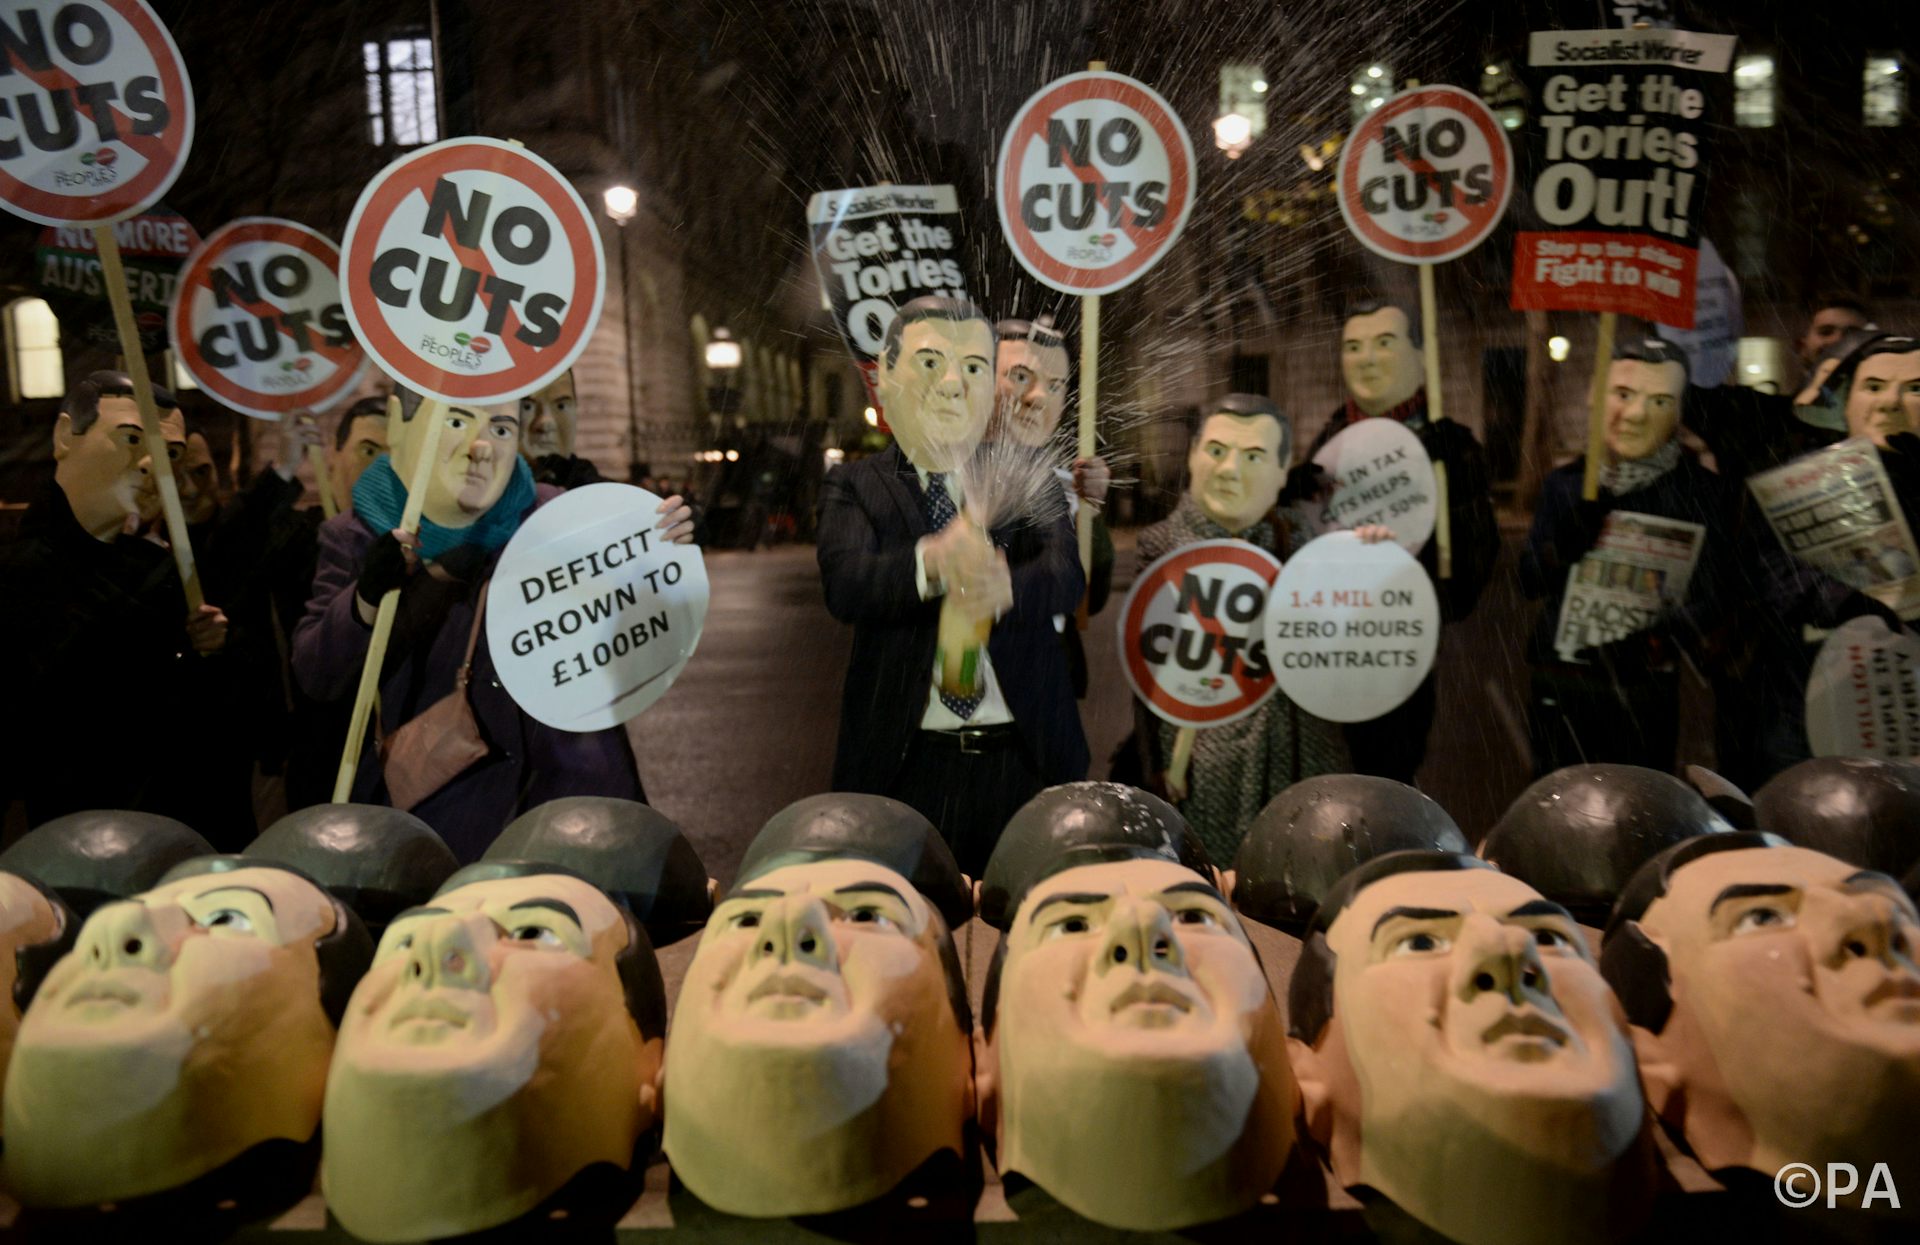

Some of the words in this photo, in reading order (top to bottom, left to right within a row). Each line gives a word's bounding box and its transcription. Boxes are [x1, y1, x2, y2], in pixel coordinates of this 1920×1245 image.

[0, 3, 112, 76] NO
[1543, 74, 1628, 113] Get
[1639, 74, 1704, 119] the
[1047, 118, 1142, 168] NO
[1383, 119, 1466, 163] NO
[1540, 115, 1699, 169] Tories
[828, 194, 890, 217] Scialist
[1021, 181, 1168, 232] CUTS
[1361, 164, 1493, 215] CUTS
[1534, 162, 1696, 238] Out!
[56, 227, 97, 249] NO
[113, 220, 189, 254] MORE
[422, 177, 551, 265] NO
[827, 221, 898, 261] Get
[899, 218, 953, 250] the
[209, 255, 310, 309] NO
[369, 247, 567, 348] CUTS
[831, 251, 964, 301] Tories
[1535, 257, 1605, 287] Fight
[1611, 261, 1640, 285] to
[201, 303, 354, 369] CUTS
[1349, 465, 1369, 484] IN
[1372, 446, 1406, 471] TAX
[1360, 471, 1411, 503] HELPS
[520, 528, 652, 605] DEFICIT
[511, 583, 637, 657] GROWN
[644, 561, 683, 595] TO
[1175, 572, 1265, 624] NO
[1291, 591, 1324, 608] 1.4
[1332, 590, 1374, 608] MIL
[1381, 590, 1413, 607] ON
[552, 611, 670, 687] £100BN
[1140, 623, 1272, 678] CUTS
[1277, 620, 1337, 638] ZERO
[1346, 620, 1423, 637] HOURS
[1283, 650, 1417, 669] CONTRACTS
